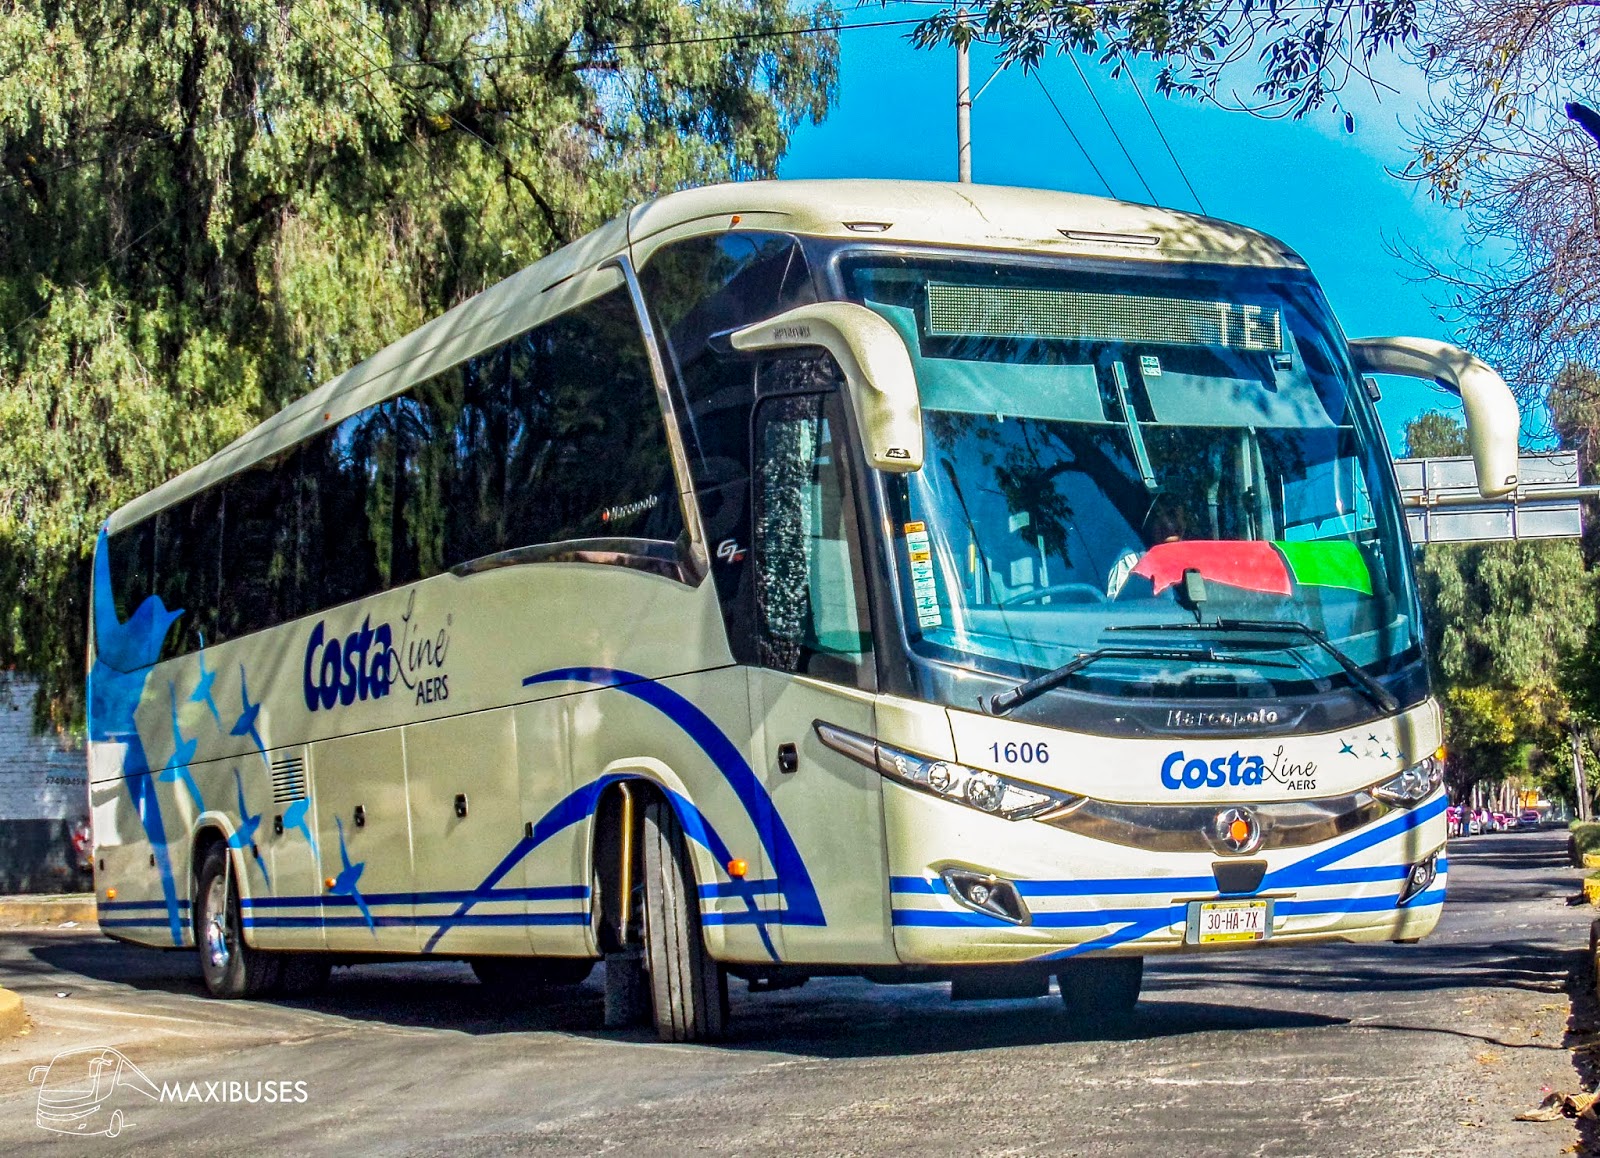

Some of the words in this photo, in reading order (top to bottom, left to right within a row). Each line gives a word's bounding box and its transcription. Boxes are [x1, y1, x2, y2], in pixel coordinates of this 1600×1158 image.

[303, 613, 392, 712] Costa
[386, 588, 451, 690] Line
[415, 675, 449, 706] AERS
[988, 741, 1050, 764] 1606
[1160, 750, 1265, 790] Costa
[1260, 744, 1318, 784] Line
[1286, 779, 1317, 791] AERS
[1207, 911, 1259, 930] 30-HA-7X
